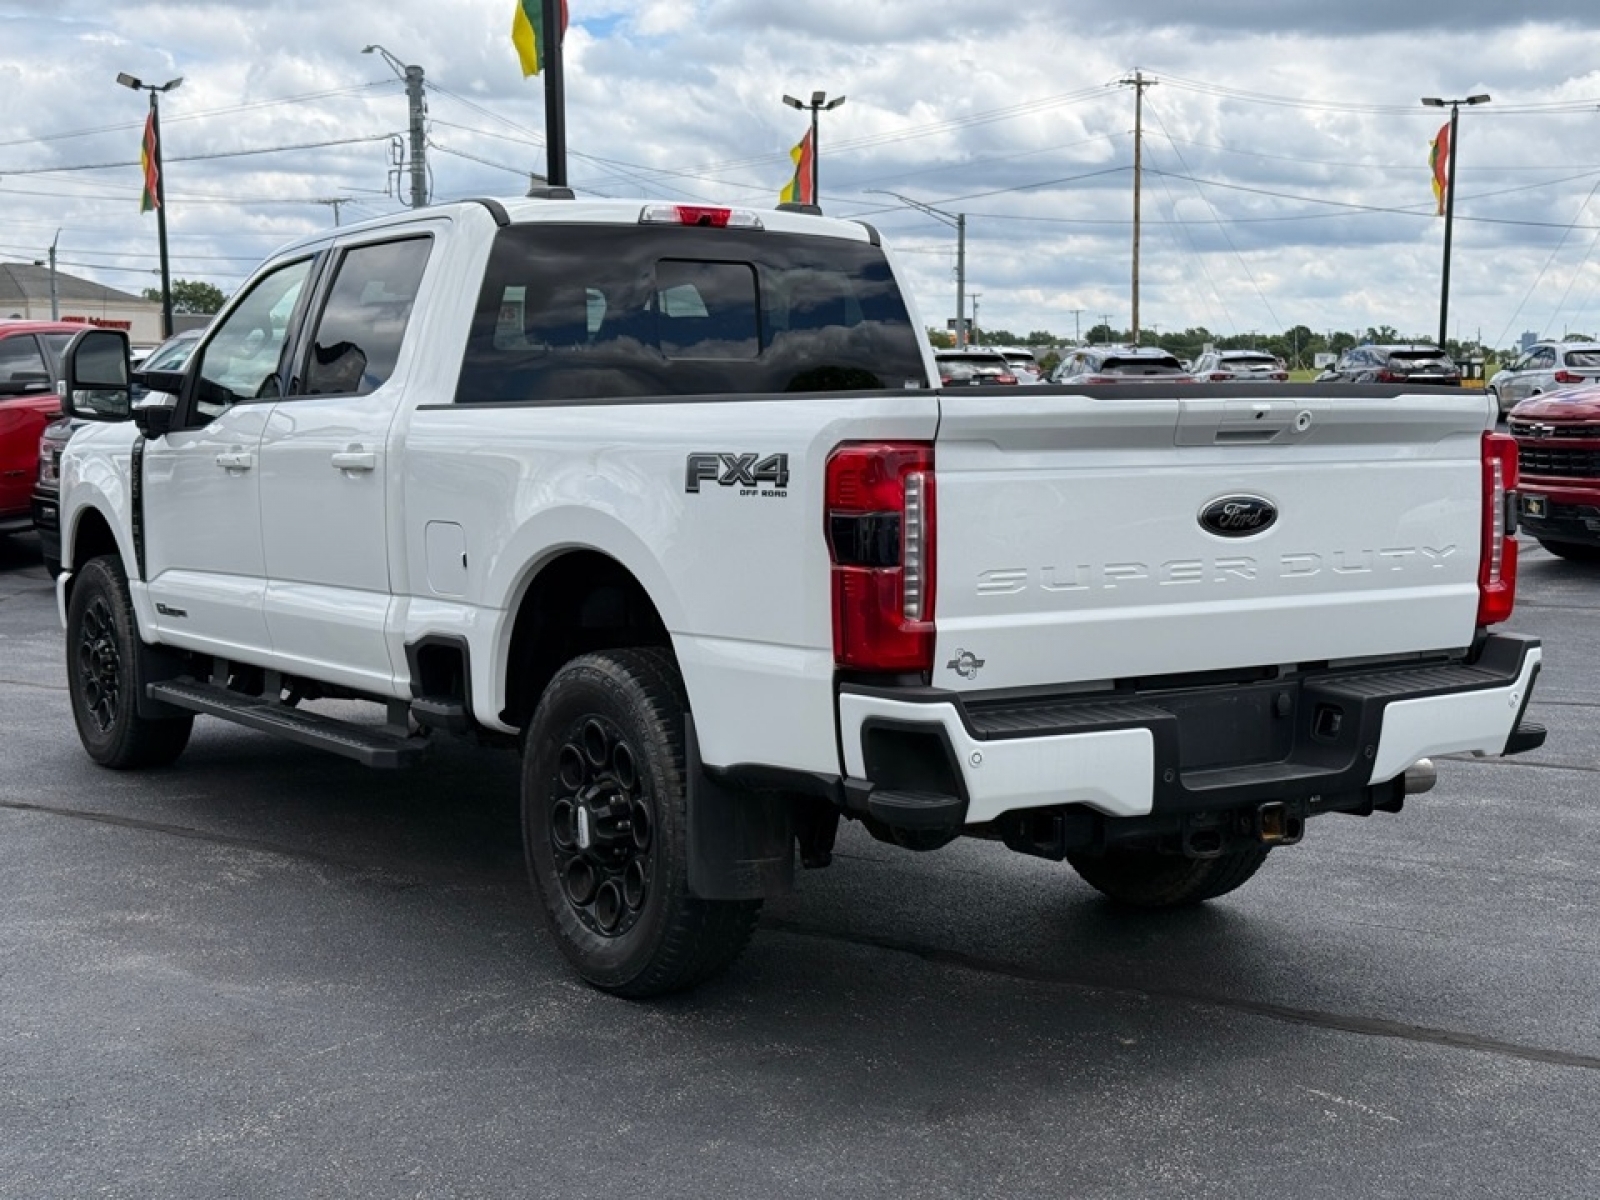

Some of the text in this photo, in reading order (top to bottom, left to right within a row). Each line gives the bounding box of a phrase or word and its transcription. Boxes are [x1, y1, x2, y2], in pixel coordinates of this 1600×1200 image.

[685, 452, 790, 494] FX4
[739, 489, 788, 498] OFF ROAD
[1218, 502, 1264, 528] Ford
[975, 543, 1458, 597] SUPER DUTY
